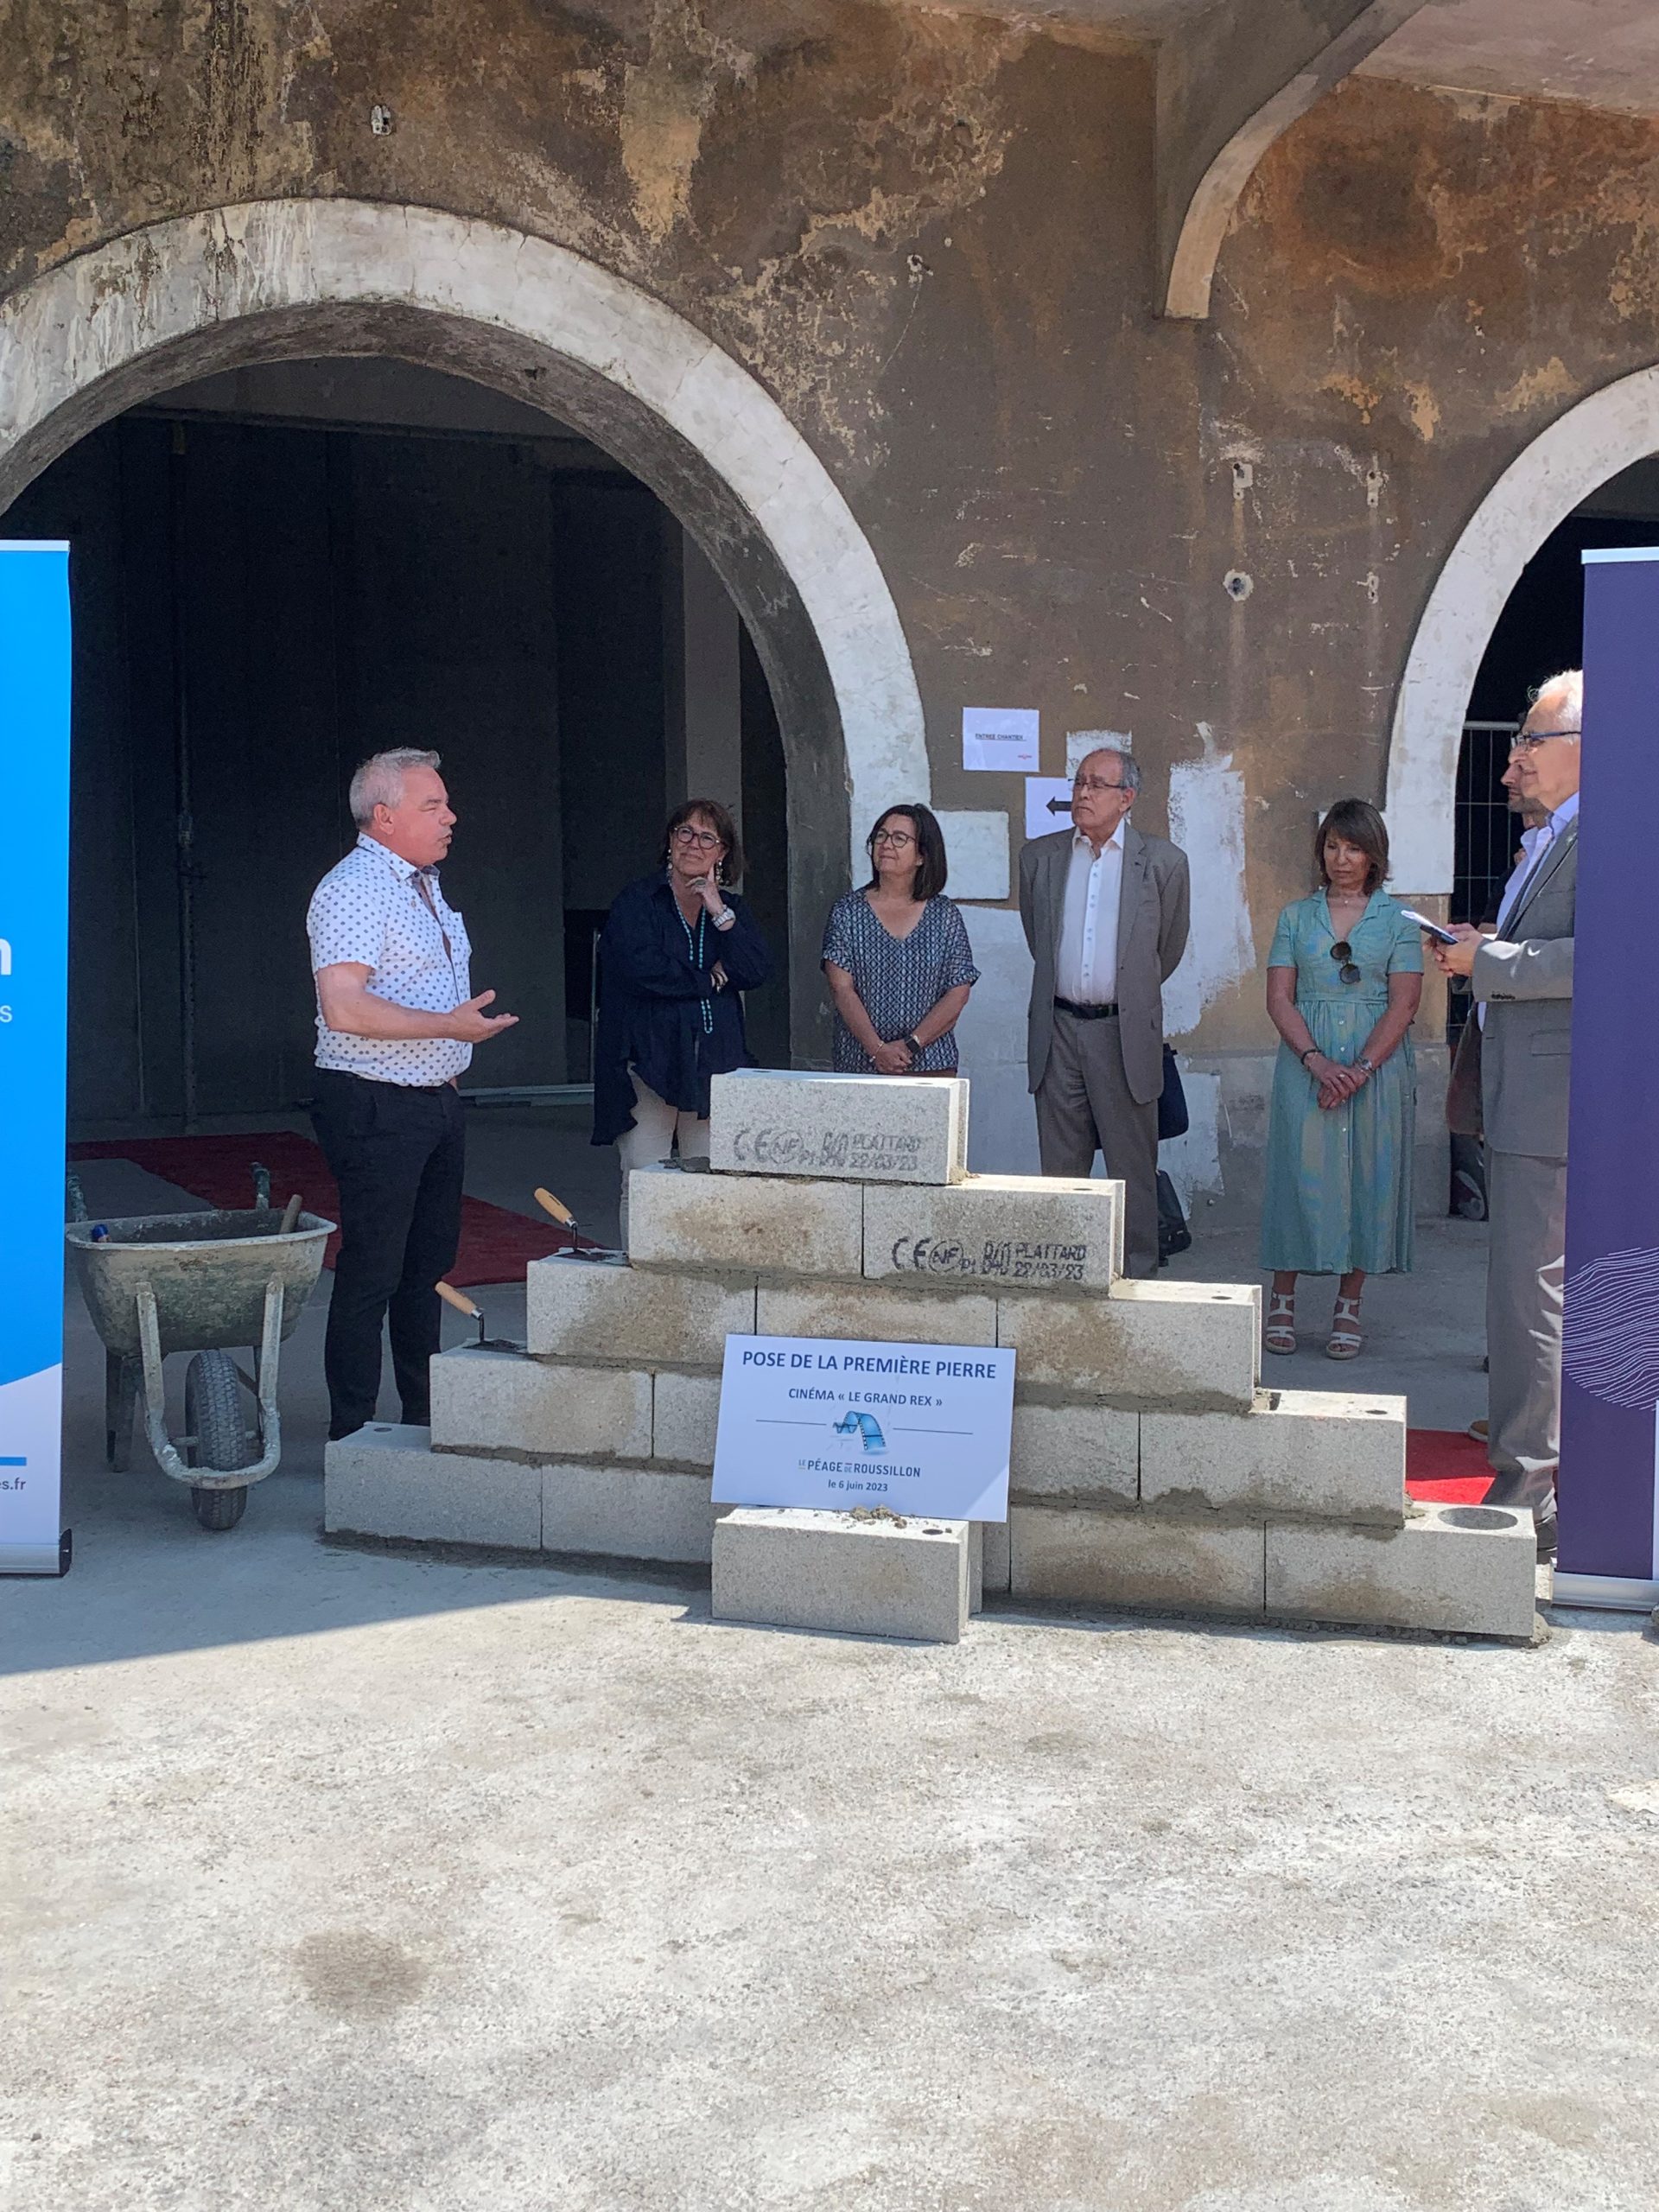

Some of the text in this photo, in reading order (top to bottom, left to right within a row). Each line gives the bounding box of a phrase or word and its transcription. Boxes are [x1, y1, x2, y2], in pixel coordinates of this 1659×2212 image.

[1015, 1242, 1087, 1262] PLATTARD
[742, 1351, 996, 1379] POSE DE LA PREMIÈRE PIERRE
[788, 1387, 835, 1402] CINÉMA
[848, 1391, 861, 1402] LE
[863, 1392, 906, 1405] GRAND
[910, 1395, 932, 1407] REX
[807, 1459, 842, 1473] PÉAGE
[854, 1464, 921, 1478] ROUSSILLON
[828, 1479, 888, 1492] le 6 juin 2023
